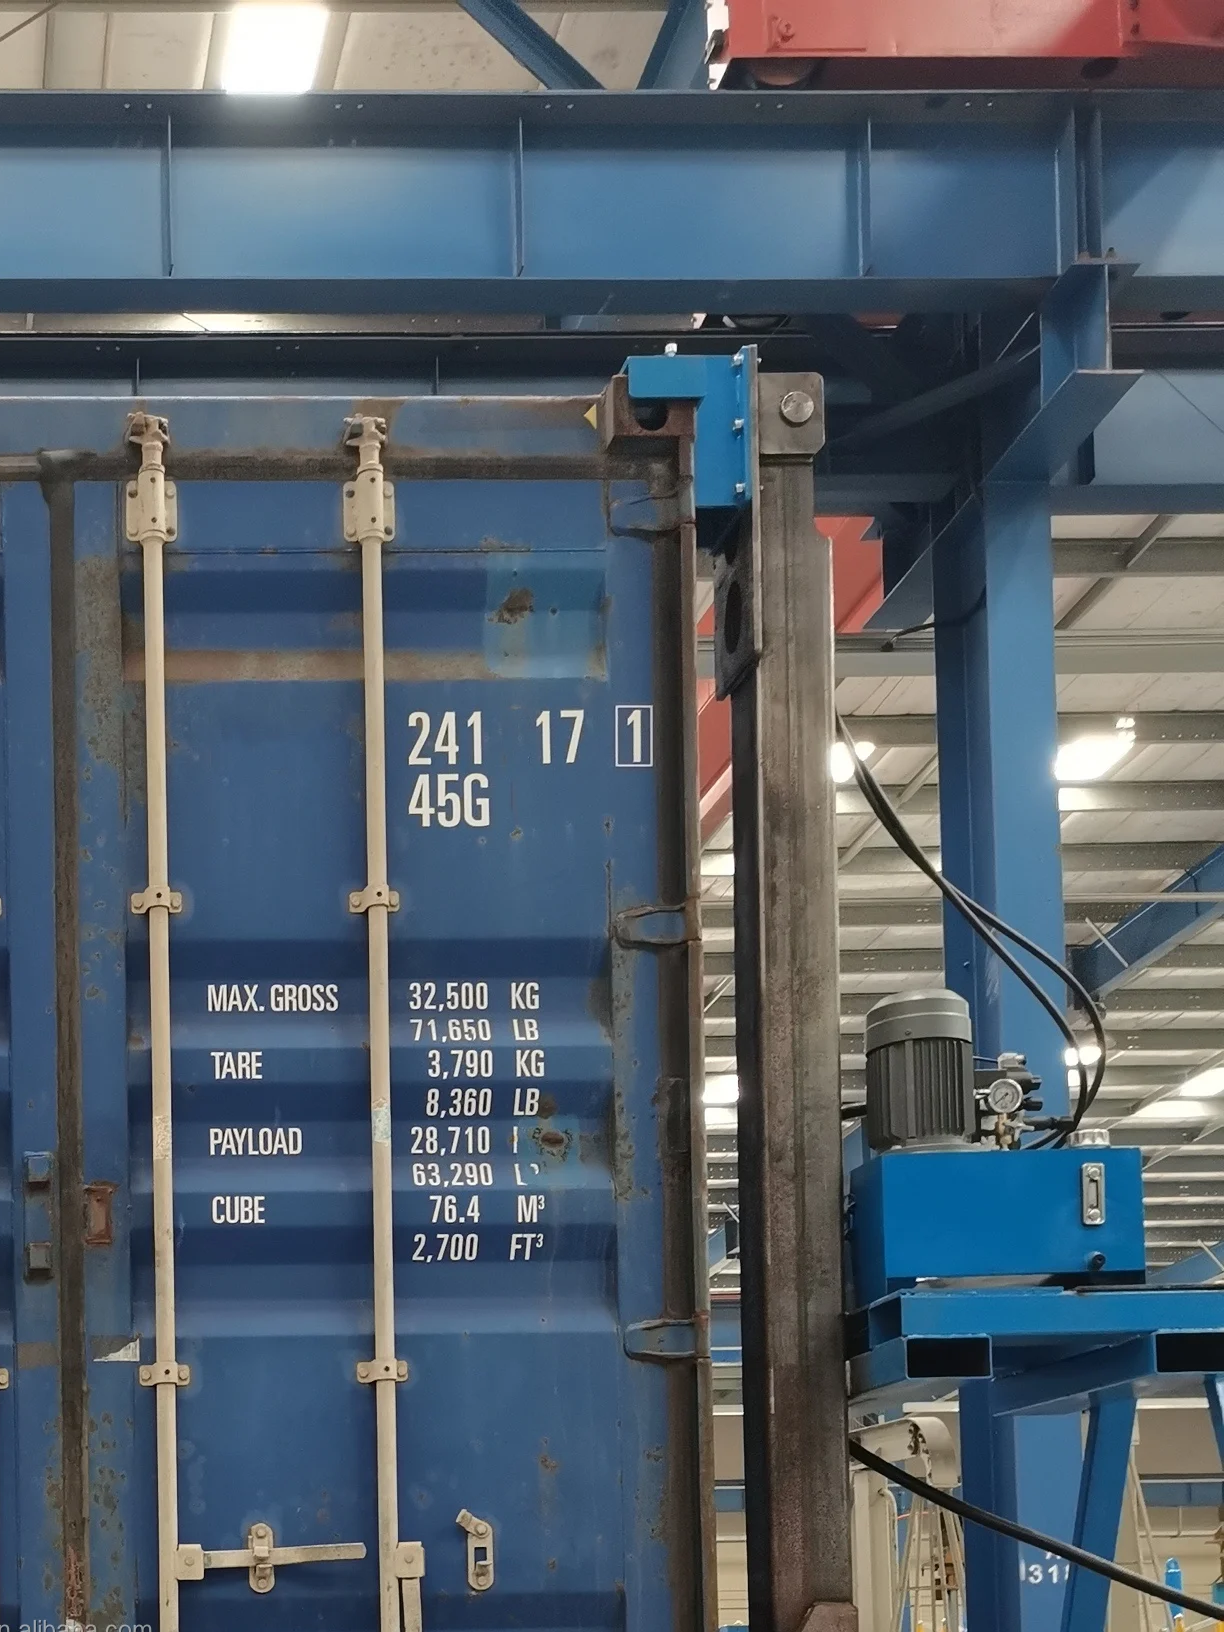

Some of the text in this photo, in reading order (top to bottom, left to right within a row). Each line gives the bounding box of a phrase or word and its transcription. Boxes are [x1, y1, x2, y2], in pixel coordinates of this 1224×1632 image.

[408, 709, 643, 766] 241 17 1
[408, 772, 490, 828] 45G
[207, 982, 540, 1012] MAX. GROSS 32,500 KG
[409, 1018, 540, 1043] 71,650 LB
[210, 1049, 545, 1080] TARE 3,790 KG
[426, 1088, 540, 1119] 8,360 LB
[209, 1127, 303, 1156] PAYLOAD
[410, 1126, 490, 1157] 28,710
[412, 1162, 494, 1188] 63,290
[212, 1195, 266, 1224] CUBE
[429, 1194, 481, 1223] 76.4
[412, 1233, 479, 1263] 2,700
